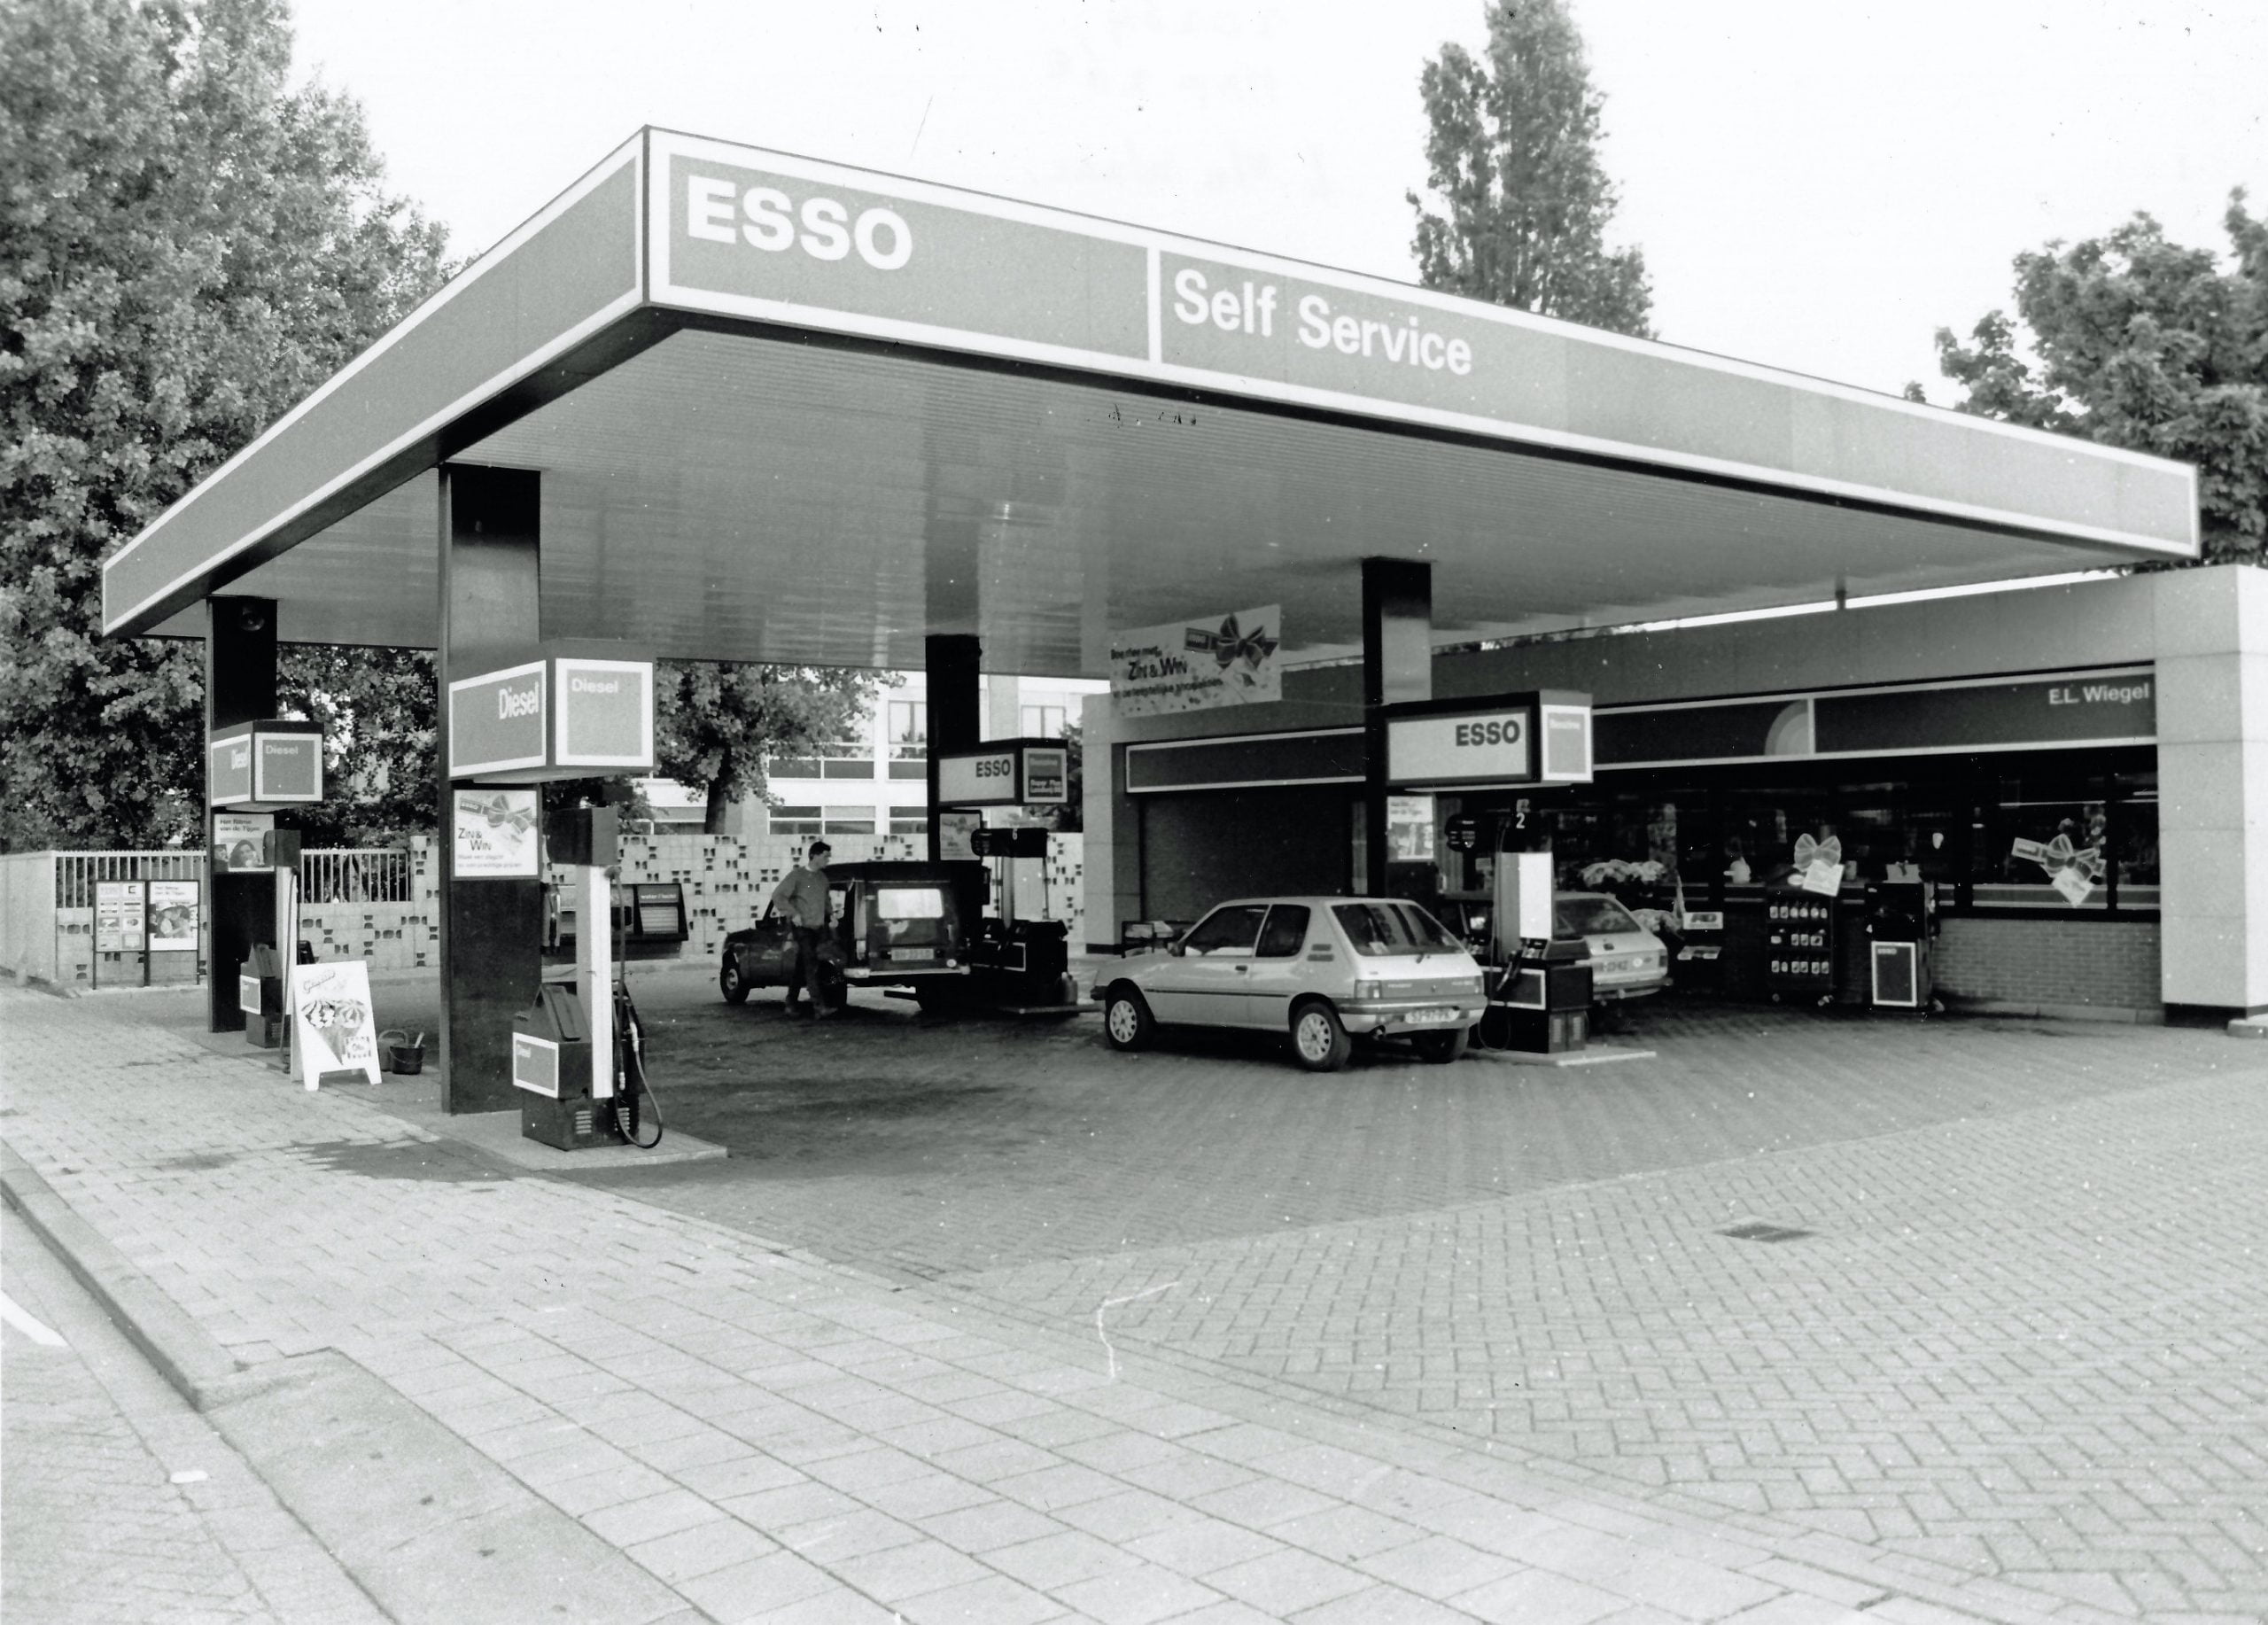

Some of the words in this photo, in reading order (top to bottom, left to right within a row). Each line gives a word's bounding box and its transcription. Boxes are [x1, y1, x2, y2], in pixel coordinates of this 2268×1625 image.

[687, 175, 913, 270] ESSO
[1173, 268, 1278, 338] Self
[1298, 294, 1472, 376] Service
[571, 678, 619, 694] Diesel
[2082, 682, 2150, 704] Wiegel
[498, 681, 540, 719] Diesel
[1455, 719, 1520, 747] ESSO
[266, 745, 299, 755] Diesel
[975, 758, 1011, 778] ESSO
[1516, 812, 1526, 828] 2
